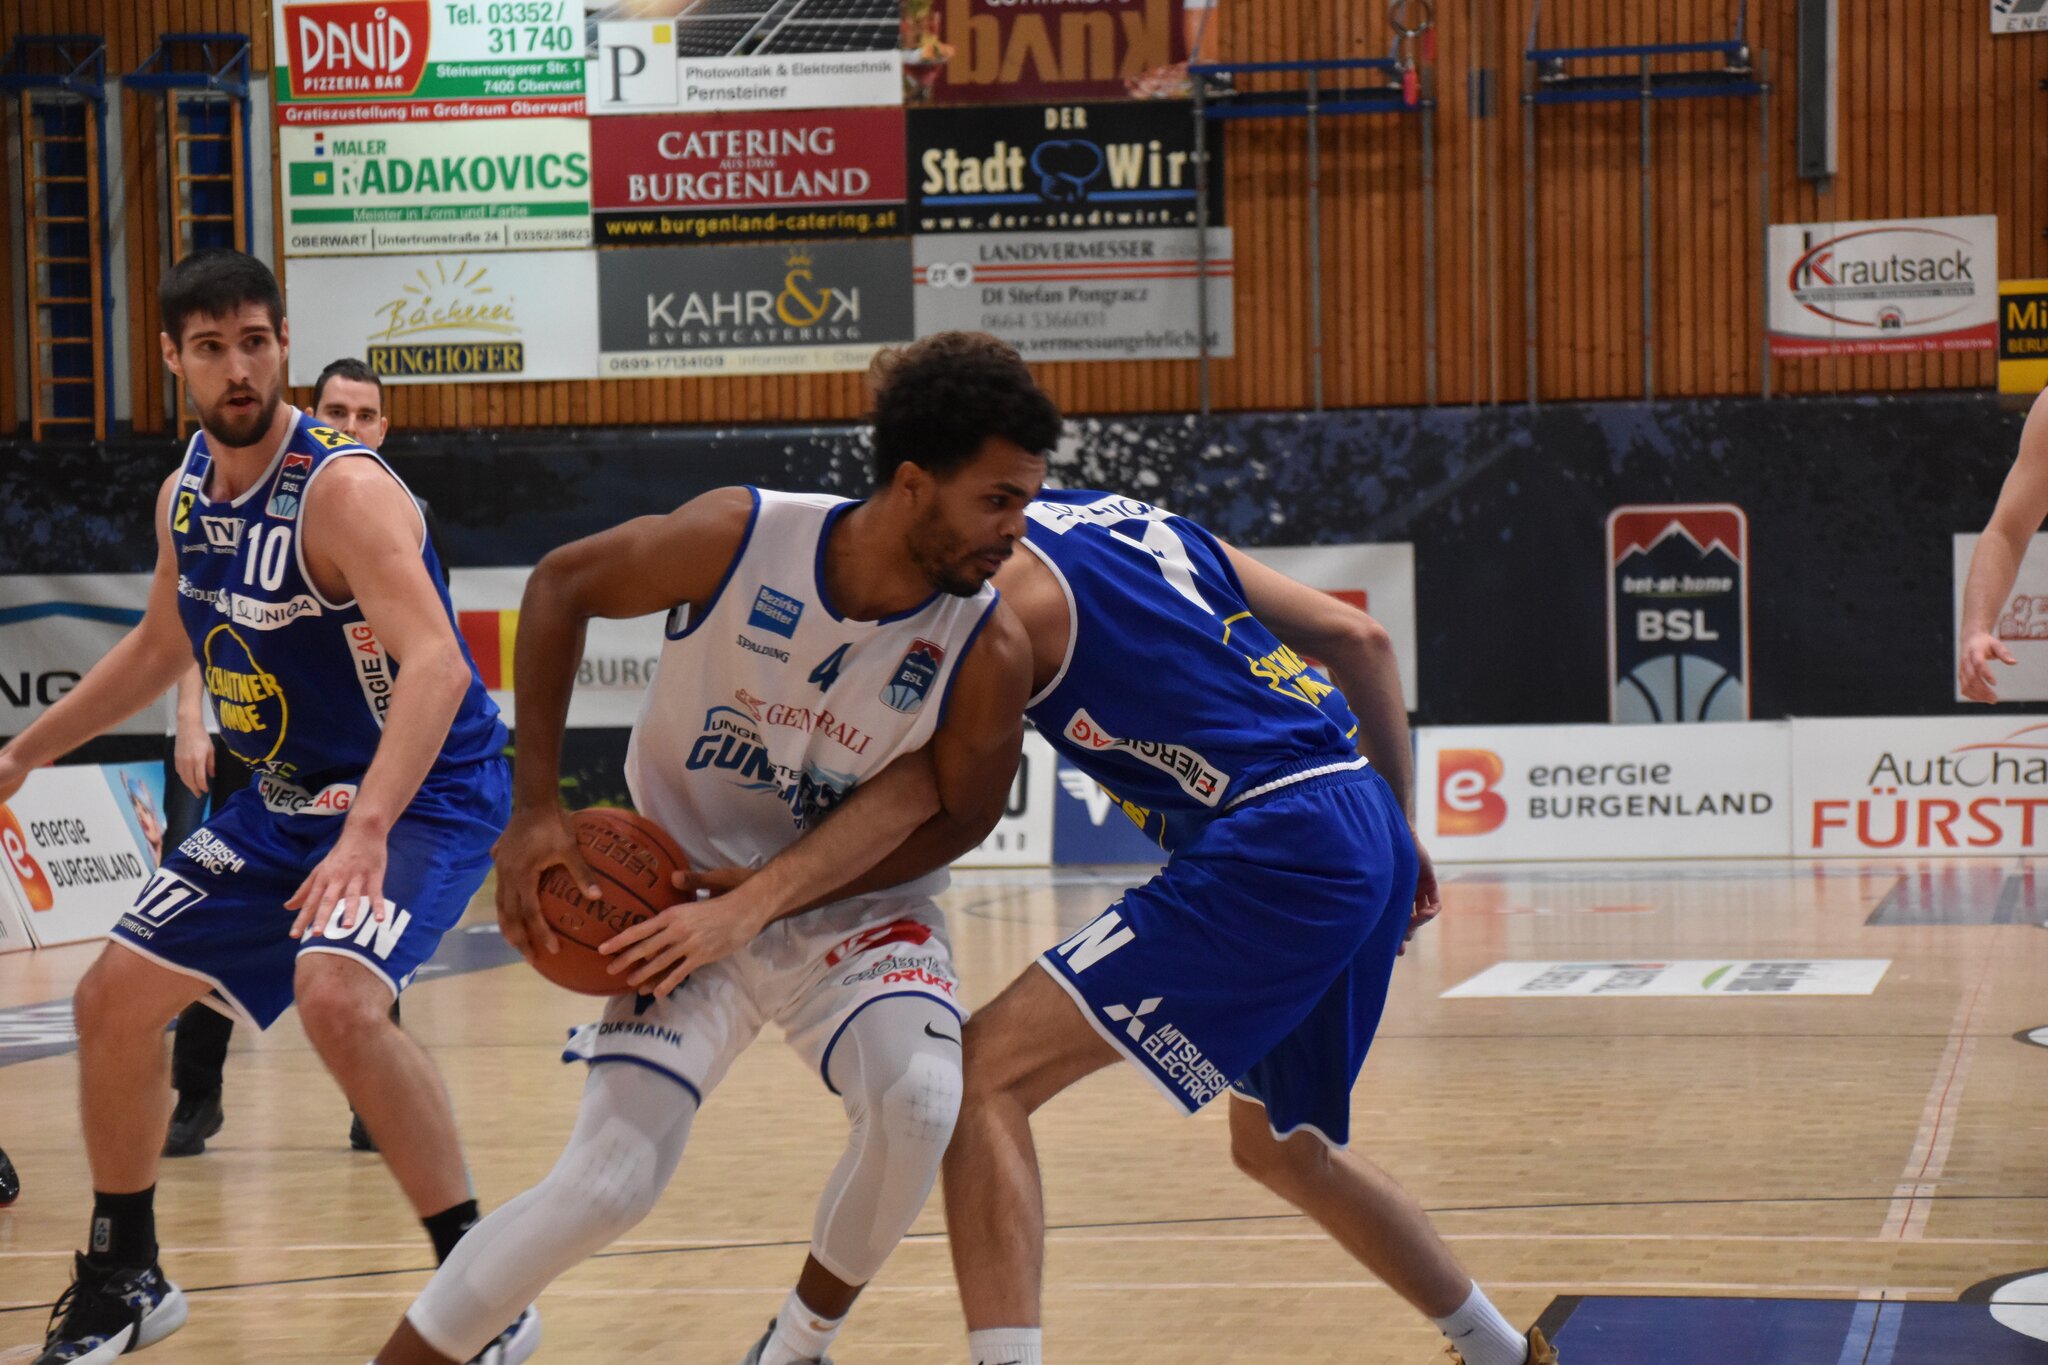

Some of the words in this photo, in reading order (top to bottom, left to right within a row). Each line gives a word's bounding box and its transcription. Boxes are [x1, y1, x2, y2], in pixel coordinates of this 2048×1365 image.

[446, 4, 482, 26] Tel.
[436, 63, 545, 80] Steinamangerer
[546, 61, 569, 75] Str.
[776, 65, 788, 76] &
[792, 61, 891, 75] Elektrotechnik
[303, 76, 370, 91] PIZZERIA
[375, 75, 404, 90] BAR
[483, 81, 515, 93] 7400
[518, 79, 581, 93] Oberwart
[687, 84, 787, 101] Pernsteiner
[286, 106, 407, 122] Gratiszustellung
[411, 105, 429, 118] im
[433, 103, 506, 118] Großraum
[511, 101, 585, 115] Oberwart!
[1044, 107, 1087, 130] DER
[332, 140, 387, 156] MALER
[657, 127, 836, 160] CATERING
[921, 140, 1027, 195] Stadt
[628, 168, 871, 202] BURGENLAND
[353, 207, 401, 222] Meister
[405, 206, 418, 219] in
[423, 205, 455, 219] Form
[465, 204, 484, 218] und
[488, 204, 528, 218] Farbe
[606, 210, 897, 237] www.burgenland-catering.at
[920, 208, 1203, 230] www.der-stadtwirt.a
[291, 235, 367, 248] OBERWART
[979, 240, 1155, 262] LANDVERMESSER
[1803, 231, 1972, 286] Krautsack
[1008, 285, 1063, 303] Stefan
[374, 296, 515, 340] Bäckerei
[372, 342, 521, 375] RINGHOFER
[244, 523, 291, 591] 10
[755, 602, 794, 626] Blätter
[759, 587, 802, 615] Bezirks
[1636, 608, 1719, 641] BSL
[352, 626, 379, 656] AG
[735, 634, 790, 664] SPALDING
[808, 642, 854, 693] 4
[901, 670, 923, 687] BSL
[766, 703, 873, 755] GENRALI
[1071, 718, 1117, 749] AG
[1528, 763, 1672, 786] energie
[316, 789, 350, 811] AG
[1528, 793, 1774, 819] BURGENLAND
[31, 818, 91, 848] energie
[48, 853, 143, 887] BURGENLAND
[598, 1021, 683, 1047] OLKSBANK
[1141, 1034, 1213, 1107] ELECTRIC
